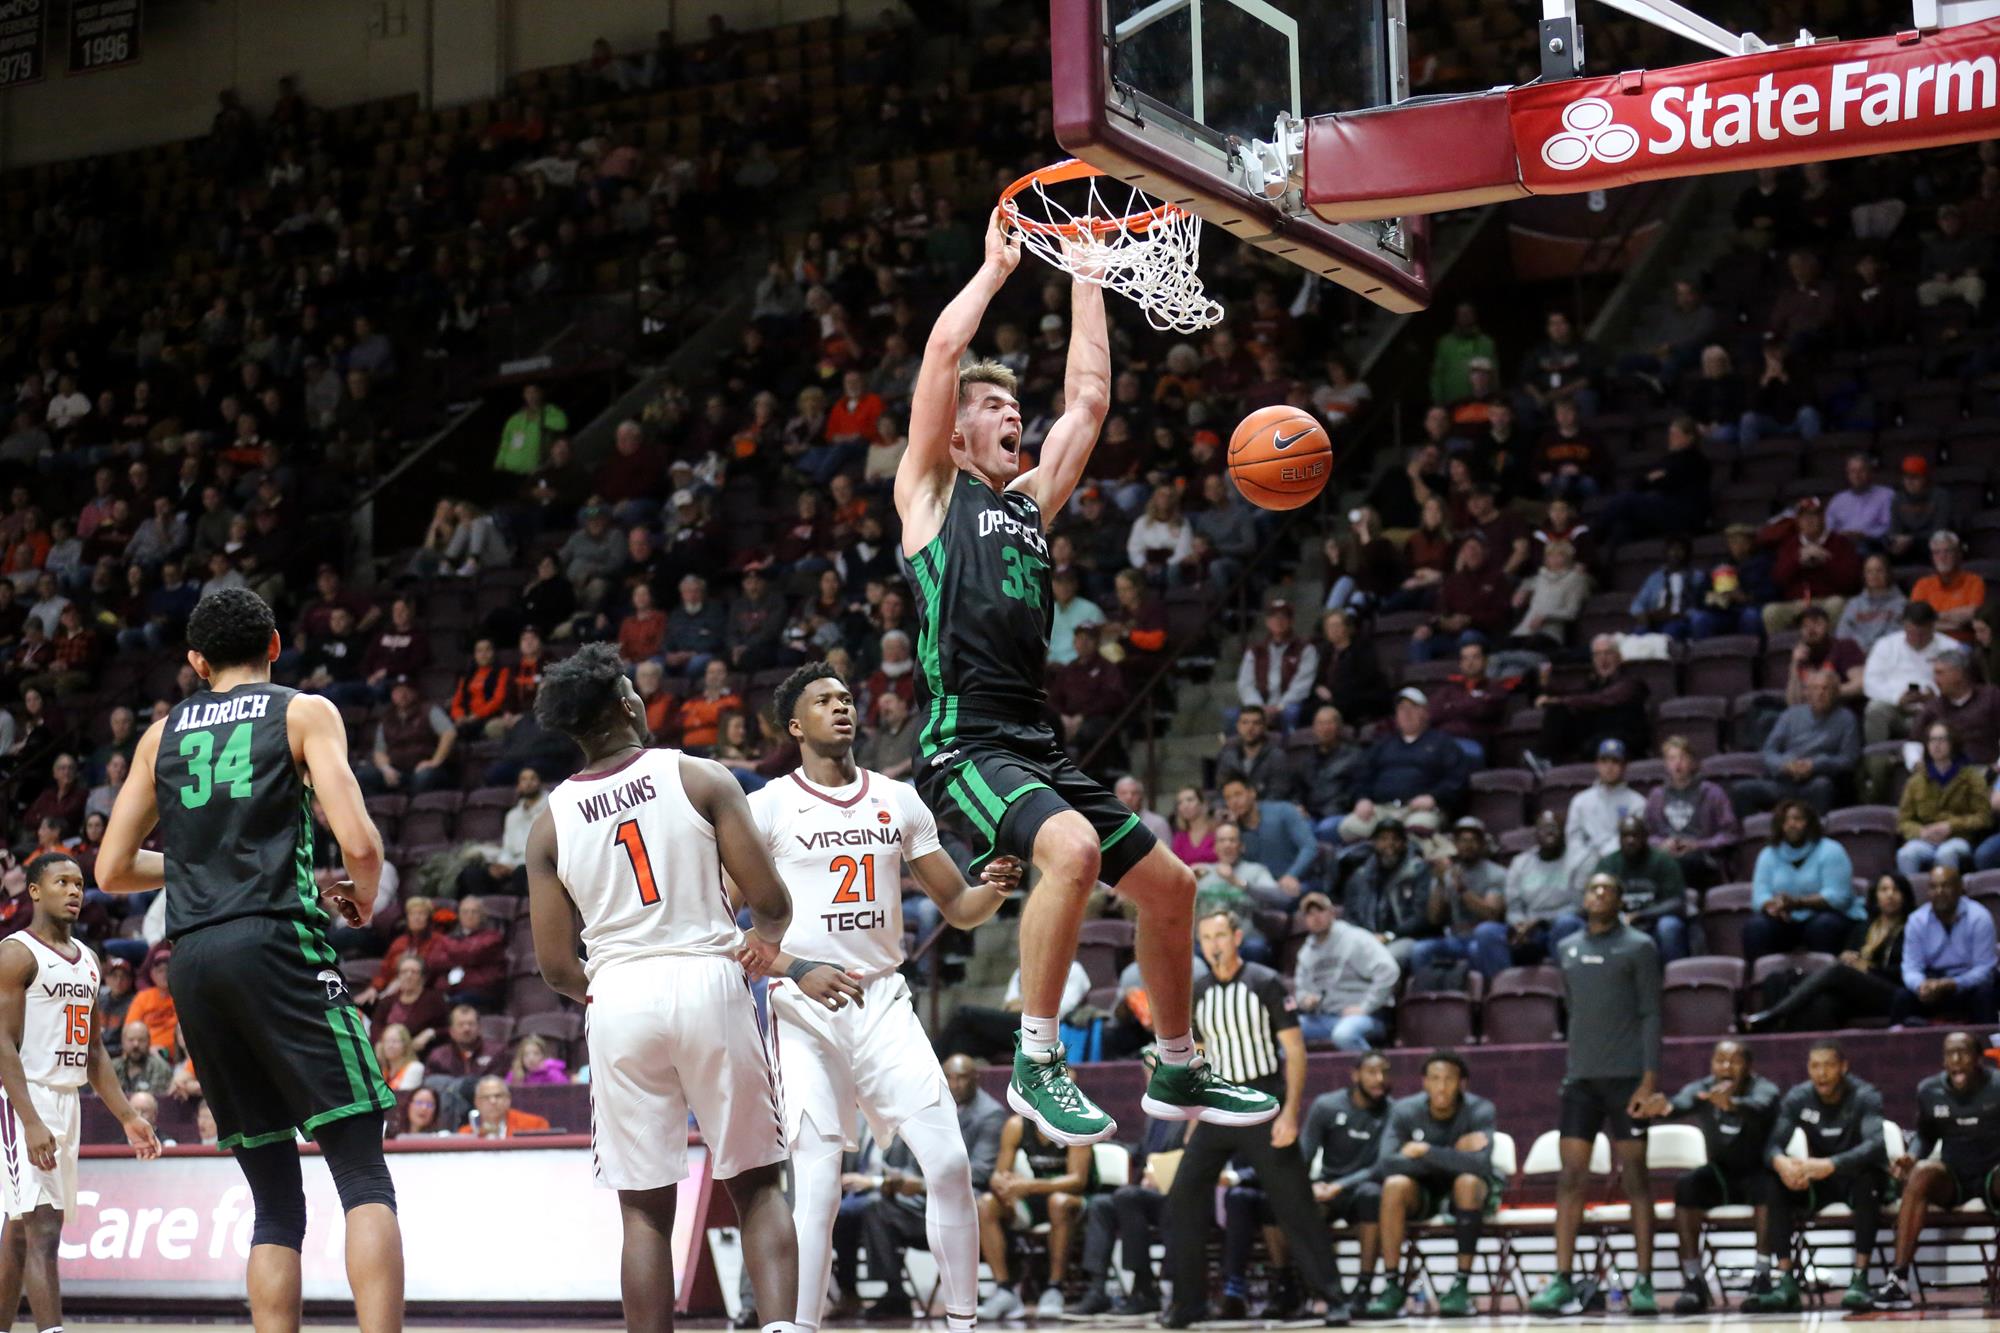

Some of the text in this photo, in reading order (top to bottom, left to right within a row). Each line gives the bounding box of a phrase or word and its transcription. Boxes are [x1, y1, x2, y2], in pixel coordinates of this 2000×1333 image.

[0, 52, 32, 82] 979
[83, 33, 129, 66] 1996
[1648, 55, 1998, 155] State Farm
[1281, 461, 1323, 481] ELITE
[1002, 546, 1048, 608] 35
[174, 694, 270, 733] ALDRICH
[179, 722, 254, 809] 34
[577, 775, 657, 824] WILKINS
[796, 827, 902, 850] VIRGINIA
[614, 818, 661, 907] 1
[829, 854, 876, 904] 21
[820, 910, 885, 932] TECH
[63, 1004, 90, 1045] 15
[58, 1190, 199, 1260] Care
